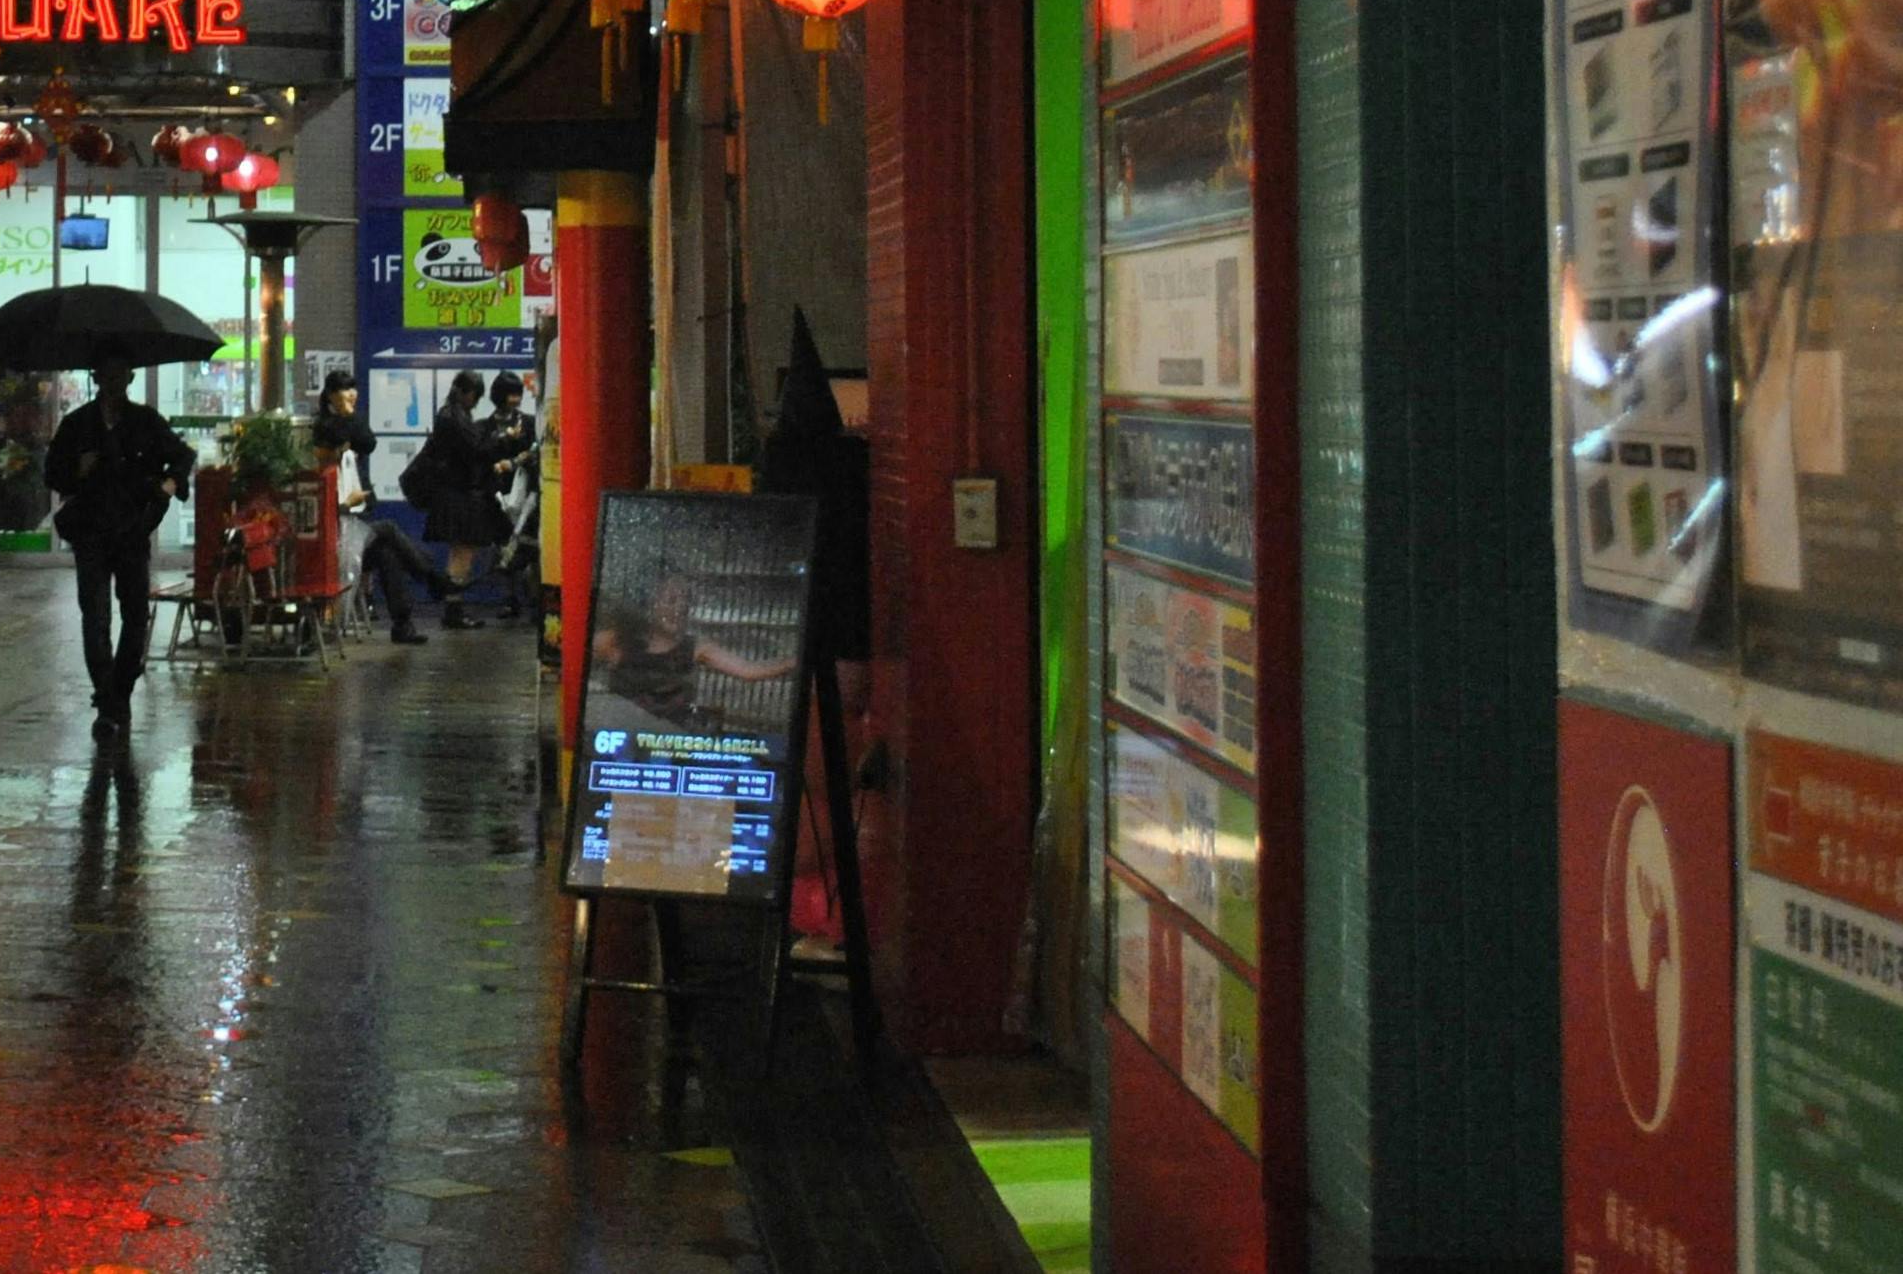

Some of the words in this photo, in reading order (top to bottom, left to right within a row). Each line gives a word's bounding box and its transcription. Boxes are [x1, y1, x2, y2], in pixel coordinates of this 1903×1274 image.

[408, 91, 448, 115] ドクタ
[369, 123, 402, 151] 2F
[371, 254, 402, 282] 1F
[439, 337, 462, 353] 3F
[492, 337, 513, 353] 7F
[594, 730, 627, 754] 6F
